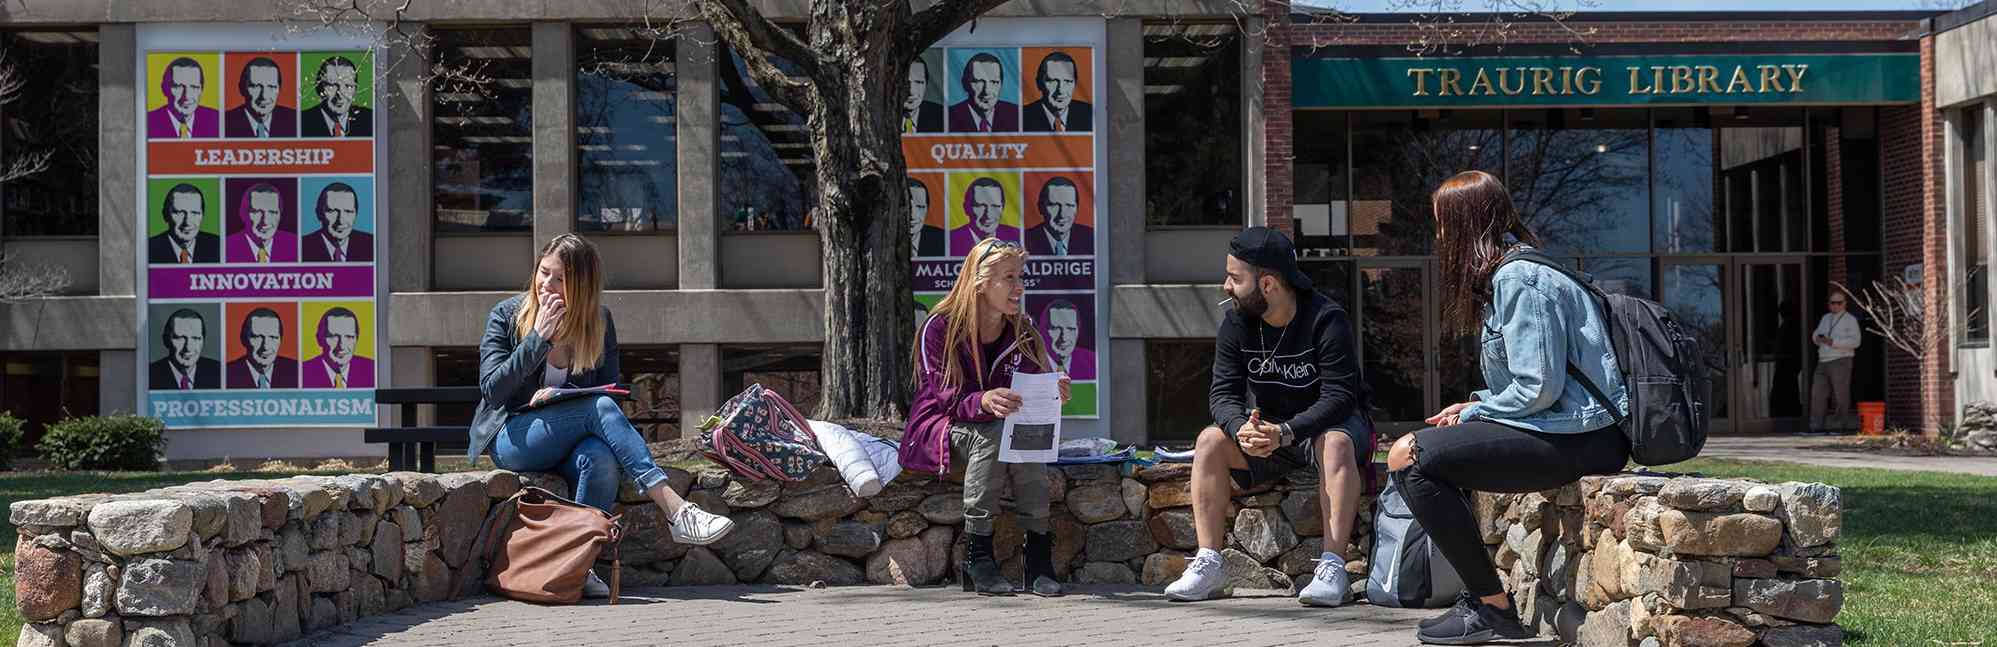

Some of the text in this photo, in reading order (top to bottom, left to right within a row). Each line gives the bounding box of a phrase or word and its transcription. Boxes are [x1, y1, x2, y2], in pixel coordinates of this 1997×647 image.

[1408, 64, 1809, 96] TRAURIG LIBRARY
[194, 149, 335, 166] LEADERSHIP
[930, 143, 1028, 163] QUALITY
[915, 262, 1092, 277] MALC ALDRIGE
[189, 273, 334, 291] INNOVATION
[934, 279, 956, 288] SCH
[1283, 360, 1317, 380] Klein
[153, 398, 373, 417] PROFESSIONALISM
